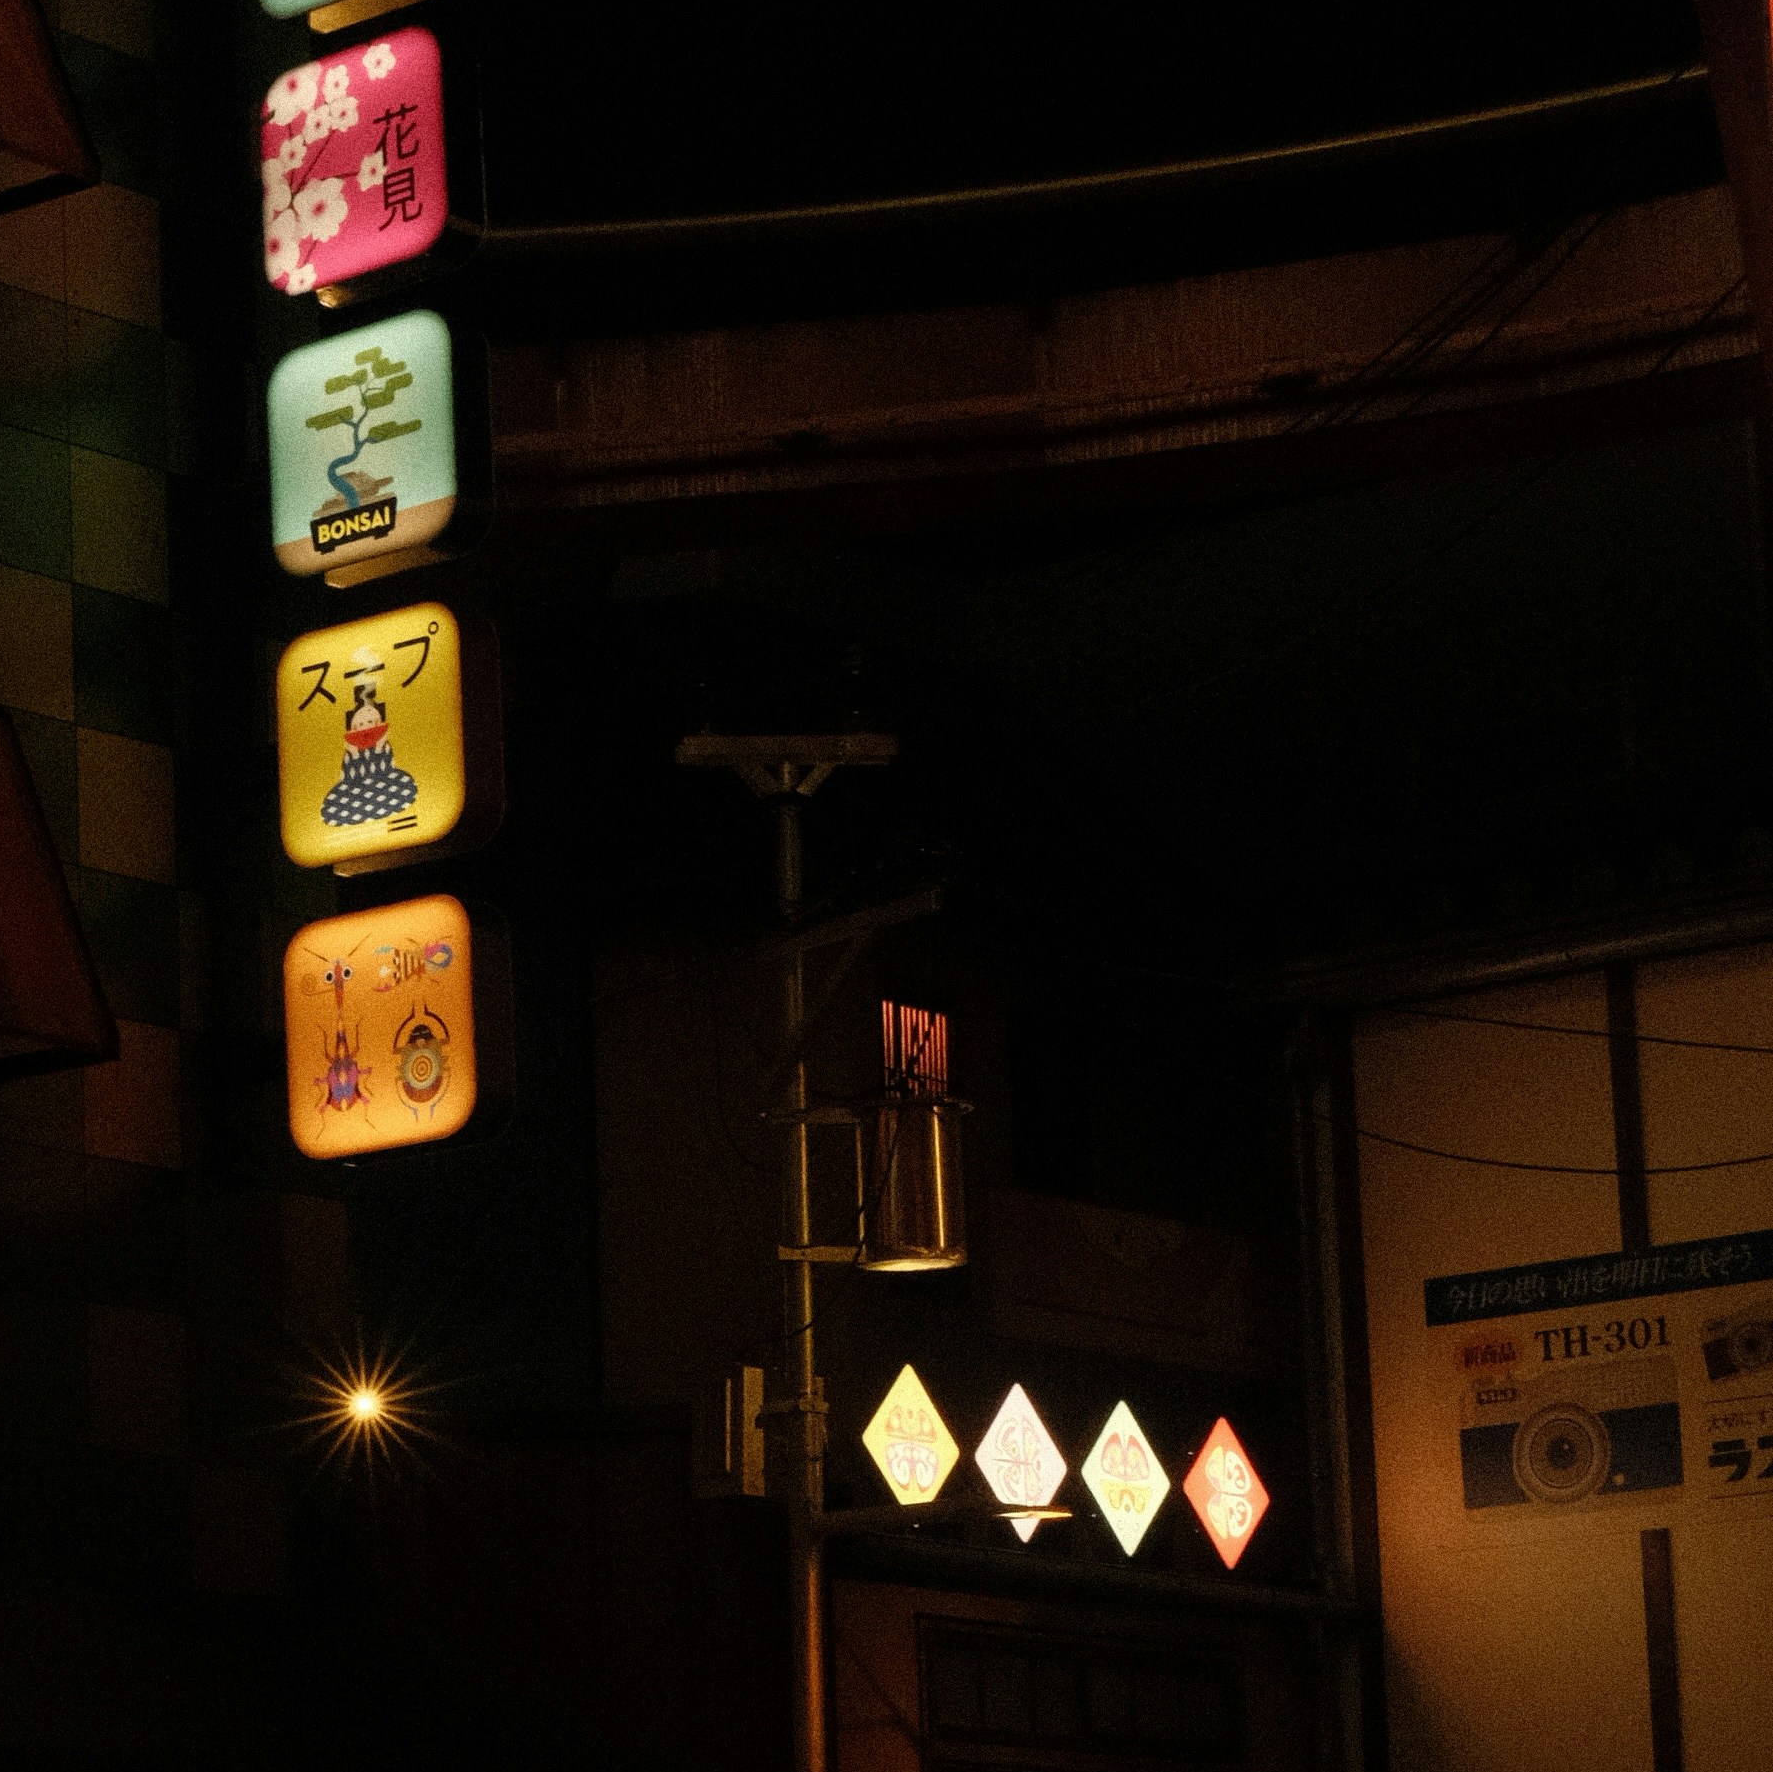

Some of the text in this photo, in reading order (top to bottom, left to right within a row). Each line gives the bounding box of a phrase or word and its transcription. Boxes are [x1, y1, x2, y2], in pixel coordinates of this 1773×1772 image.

[371, 104, 424, 232] 花見
[317, 506, 391, 544] BONSAI
[297, 620, 440, 712] スープ
[1535, 1316, 1671, 1363] TH-301
